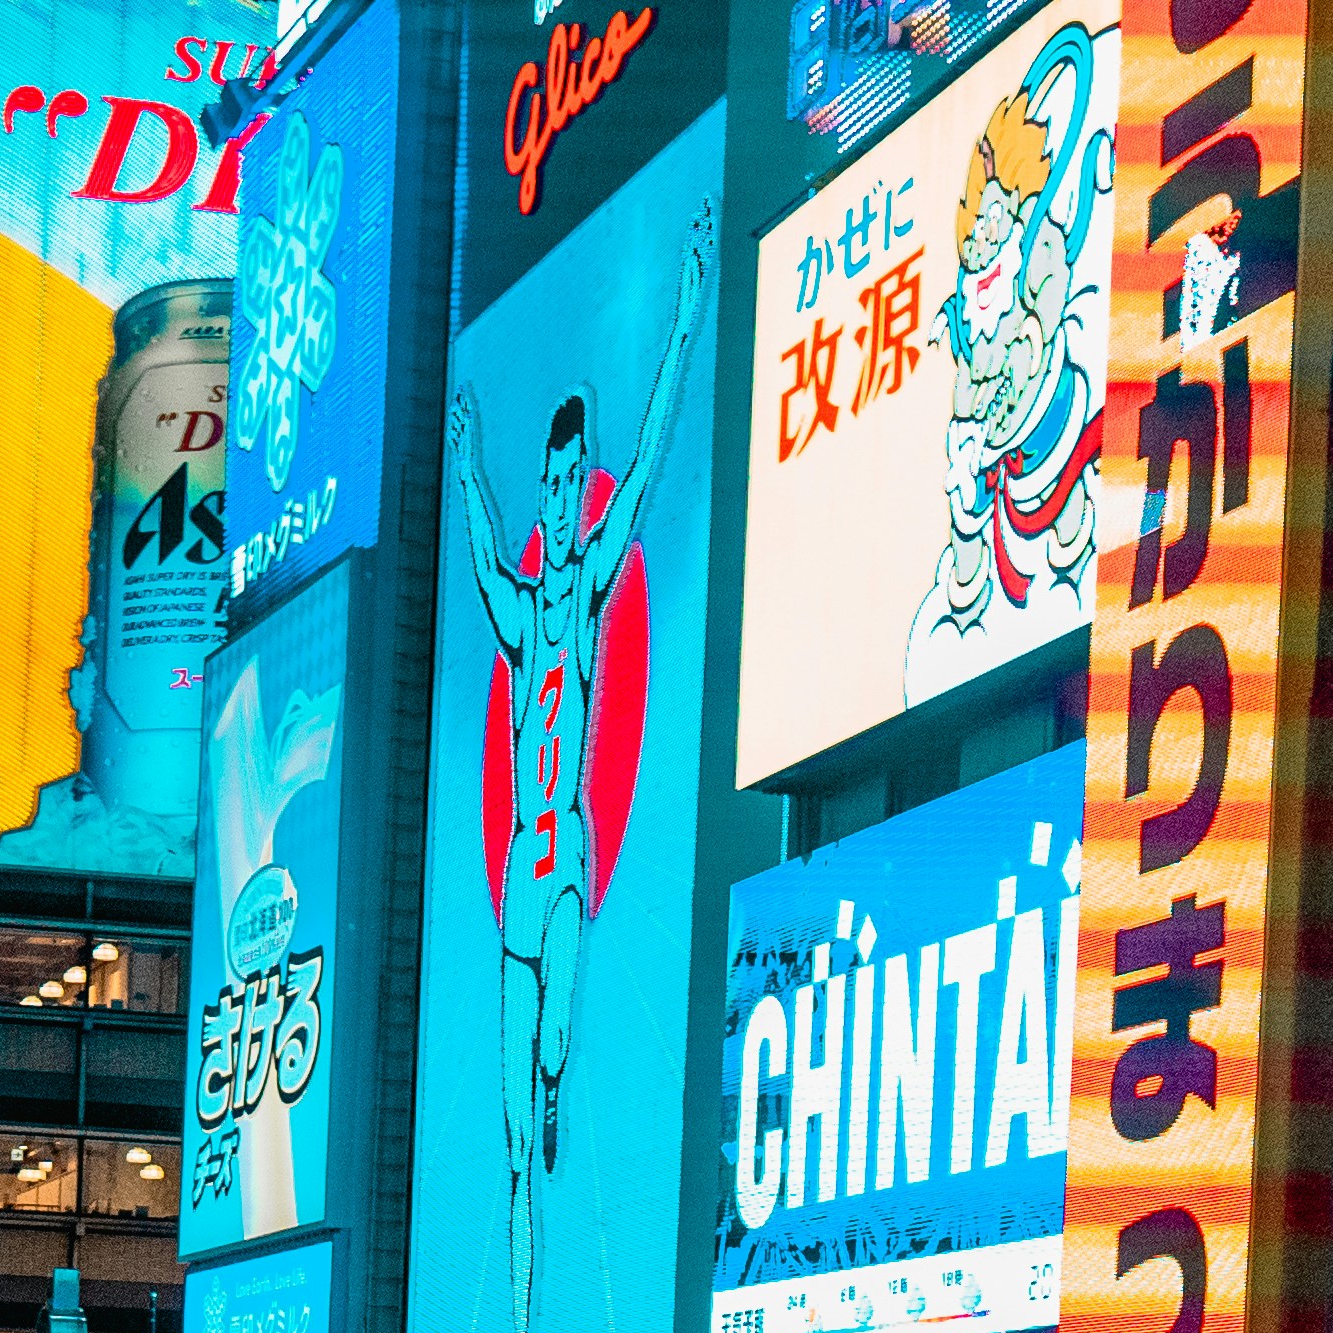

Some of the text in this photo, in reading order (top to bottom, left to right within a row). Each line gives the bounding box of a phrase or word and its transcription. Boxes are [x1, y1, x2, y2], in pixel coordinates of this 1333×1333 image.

[504, 6, 652, 215] Glico
[796, 176, 915, 313] かぜに
[776, 245, 926, 464] 改源
[196, 952, 324, 1134] さける
[192, 1127, 240, 1212] チーズ
